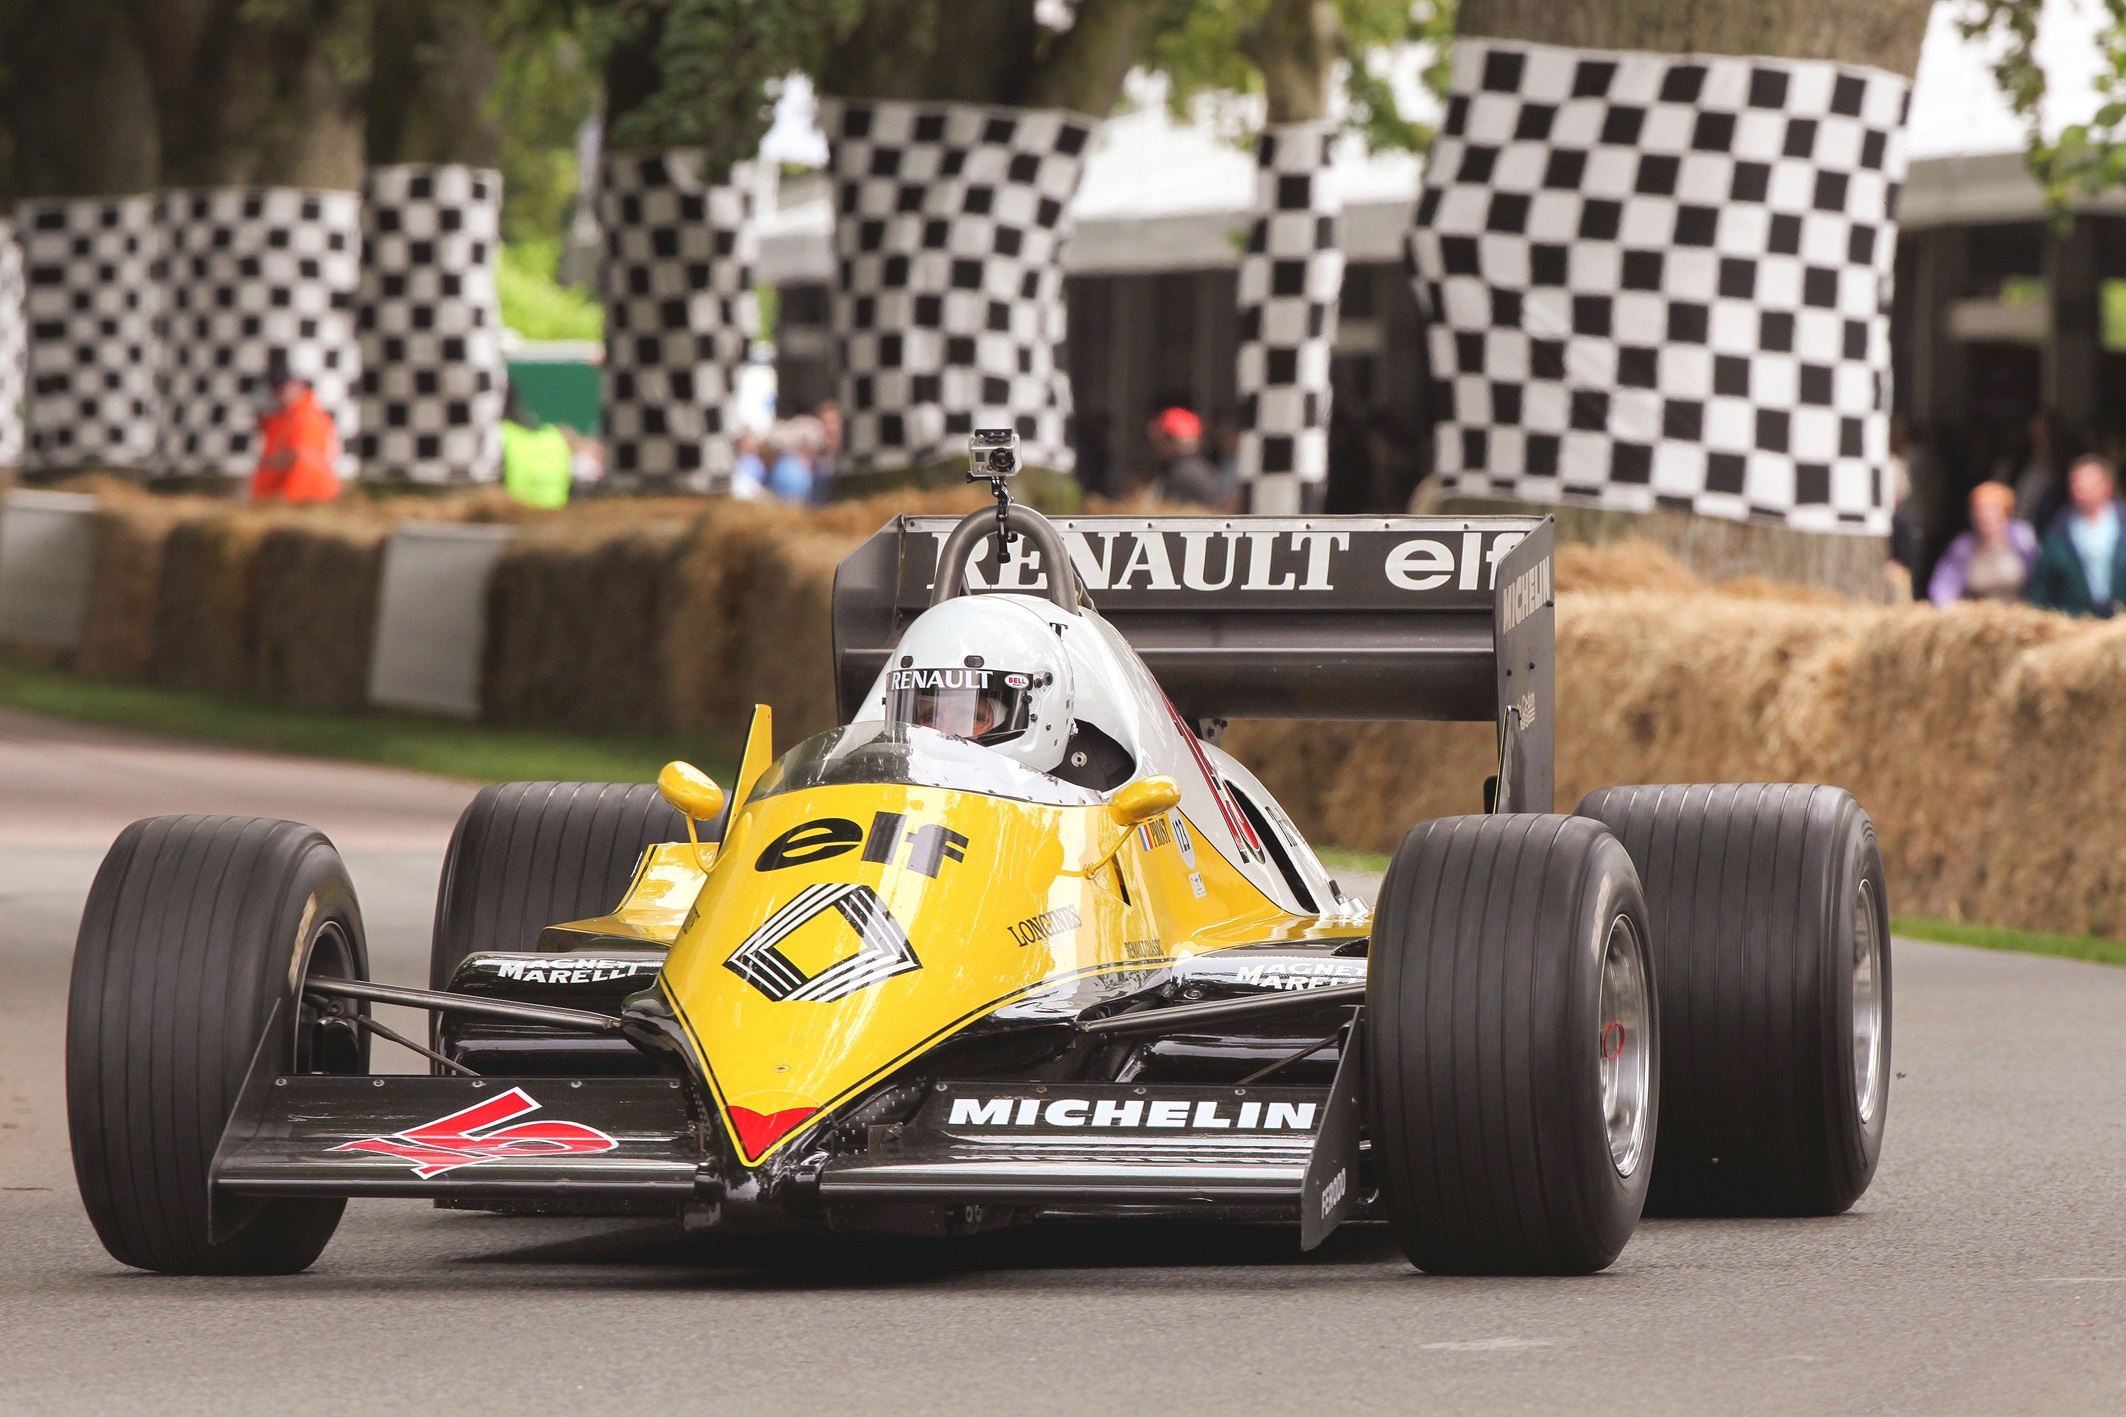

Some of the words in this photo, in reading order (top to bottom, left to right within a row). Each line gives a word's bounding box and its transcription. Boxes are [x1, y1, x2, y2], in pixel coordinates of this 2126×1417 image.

[926, 531, 1350, 591] RENAULT
[1503, 555, 1551, 635] MICHELIN
[891, 669, 994, 691] RENAULT
[1008, 677, 1027, 685] BELL
[755, 811, 969, 879] elf
[1148, 818, 1171, 848] PROST
[1008, 904, 1083, 947] LONGINES
[498, 963, 639, 984] MARELLI
[1235, 963, 1367, 981] MAGNET
[948, 1098, 1316, 1129] MICHELIN
[1321, 1167, 1347, 1220] FERODO
